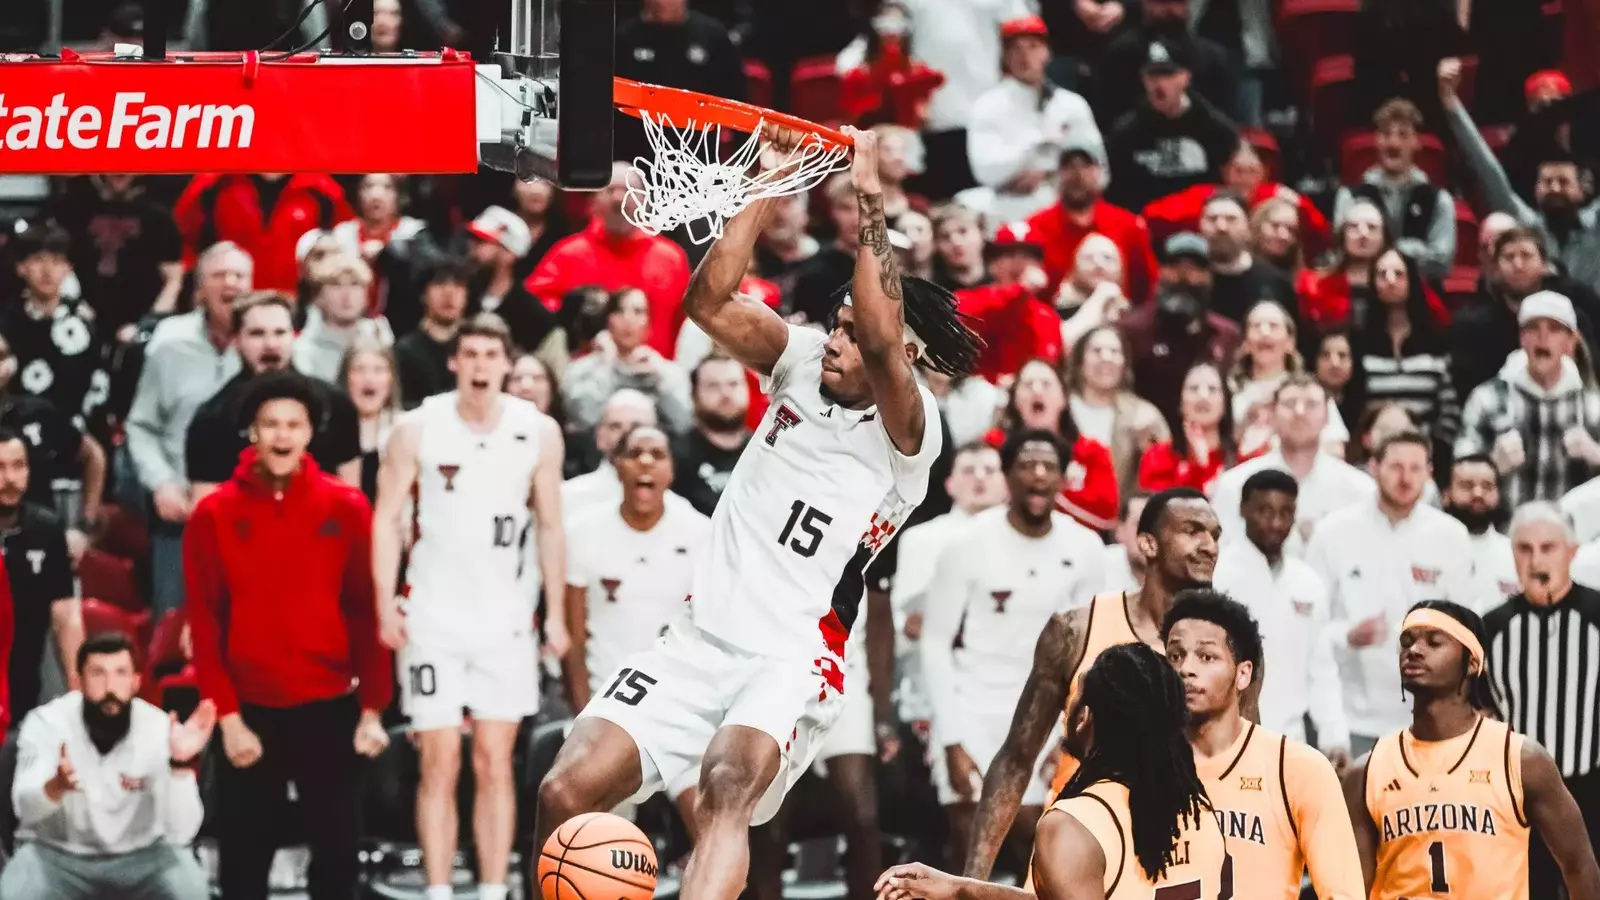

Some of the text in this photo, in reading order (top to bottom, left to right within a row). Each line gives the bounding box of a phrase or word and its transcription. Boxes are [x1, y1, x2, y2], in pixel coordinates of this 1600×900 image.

[106, 92, 255, 150] Farm
[494, 516, 514, 547] 10
[777, 500, 833, 558] 15
[410, 664, 436, 696] 10
[602, 668, 658, 706] 15
[1383, 803, 1496, 843] ARIZONA
[1428, 841, 1449, 893] 1
